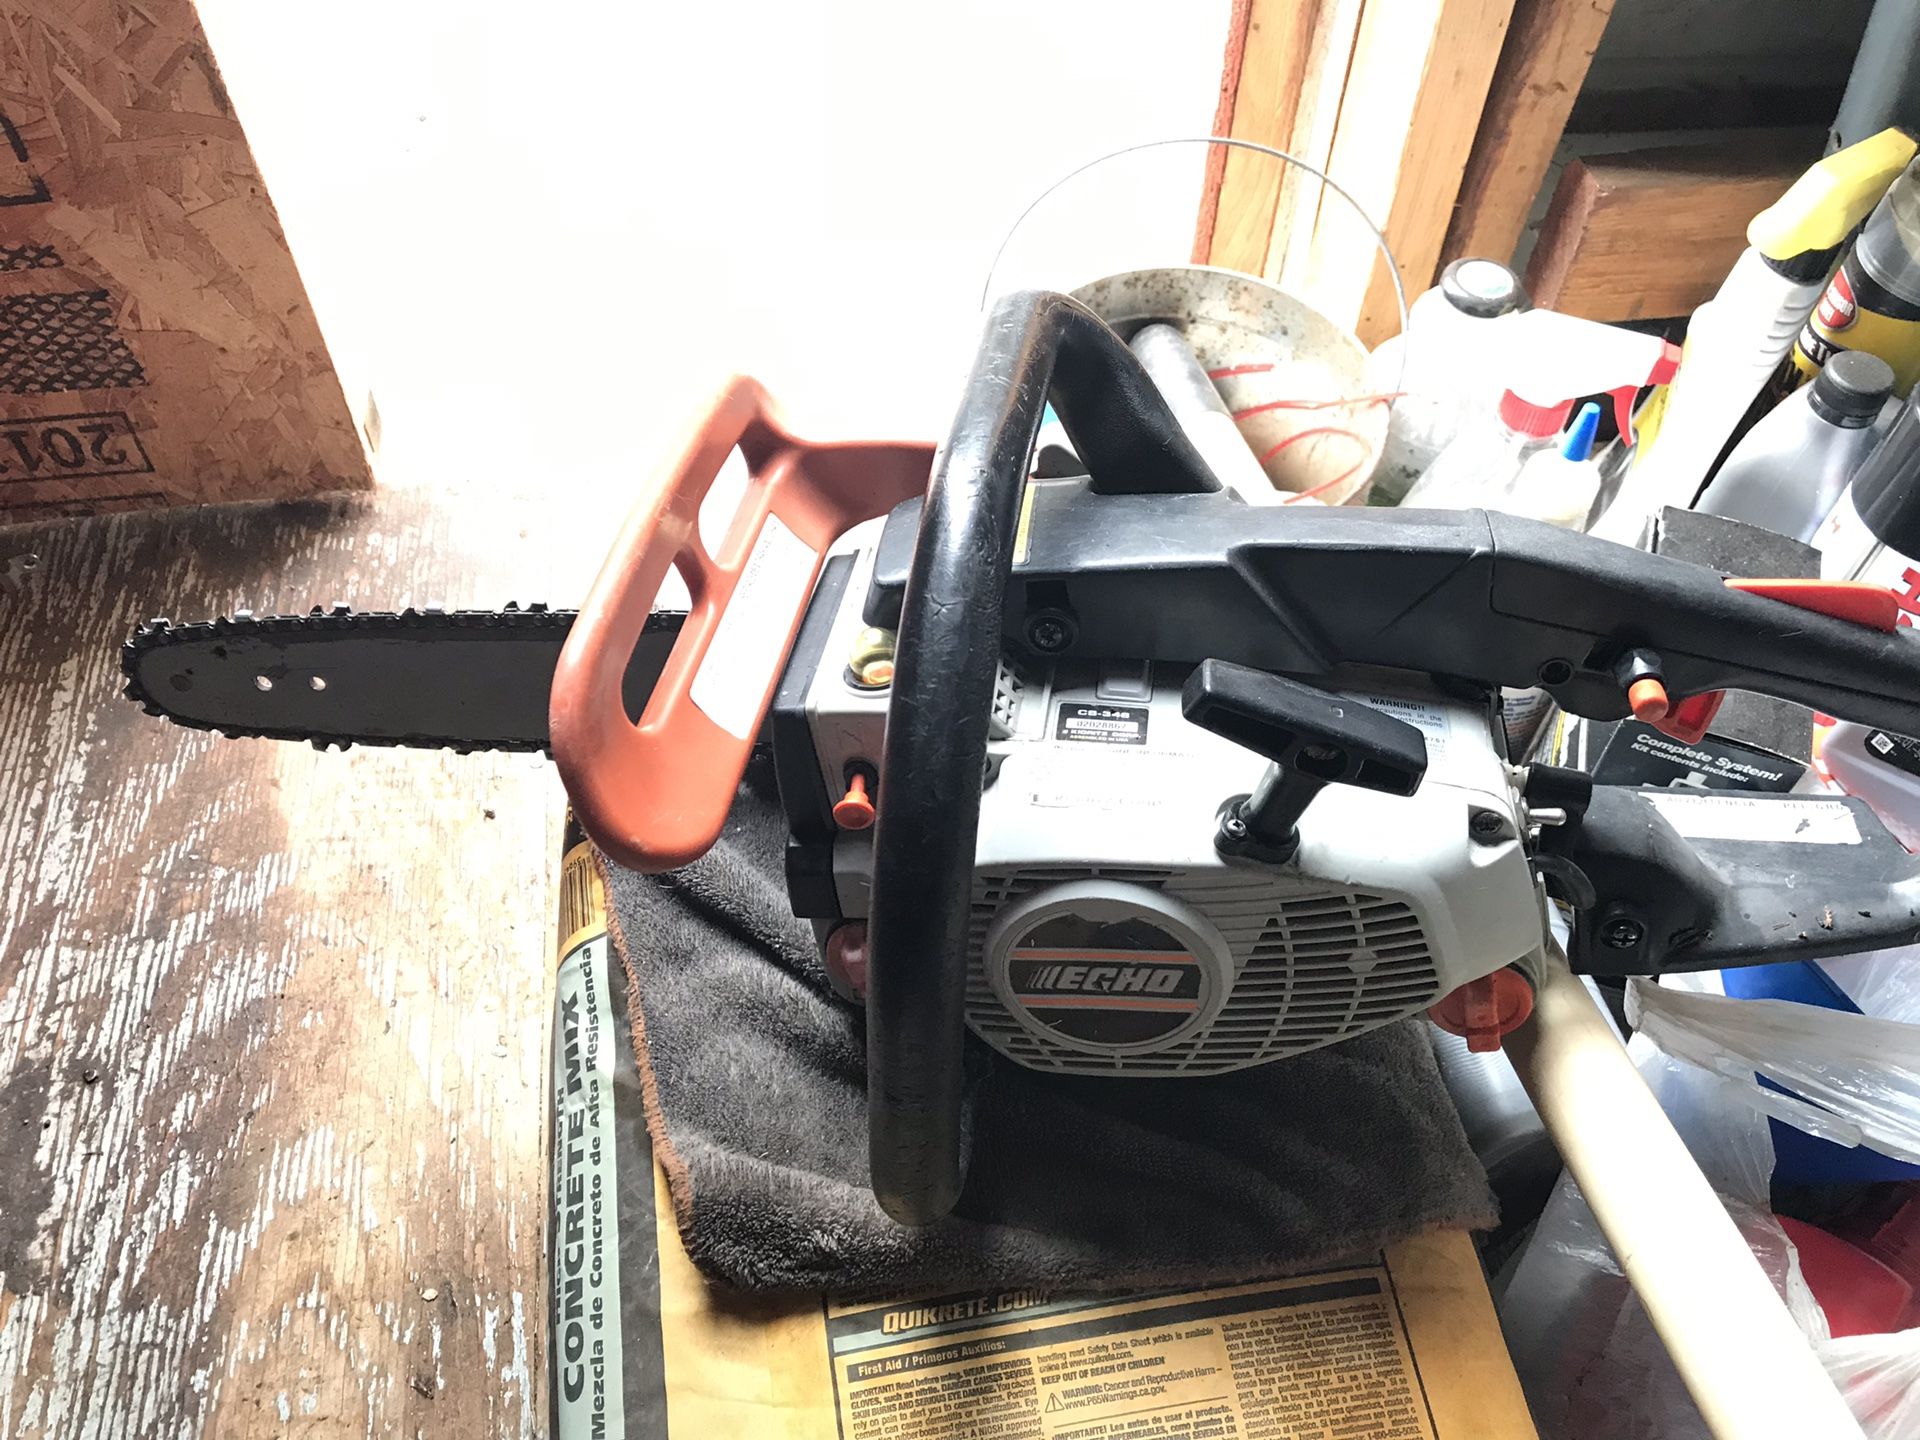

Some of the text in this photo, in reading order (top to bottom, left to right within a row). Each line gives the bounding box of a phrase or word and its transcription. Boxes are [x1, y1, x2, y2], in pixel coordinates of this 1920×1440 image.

[0, 423, 127, 473] 201
[1369, 697, 1425, 711] WARNING!!
[1630, 742, 1750, 783] Kit contents include:
[1635, 733, 1784, 782] Complete System!
[1056, 966, 1185, 993] ECHO
[561, 991, 585, 1403] CONCRETE MIX
[579, 946, 606, 1440] Mezcla de Concreto de Alta Resistencia
[858, 1363, 882, 1377] First
[885, 1359, 902, 1372] Aid
[912, 1350, 958, 1366] Primeros
[961, 1340, 1006, 1357] Auxilios:
[1041, 1356, 1166, 1386] KEEP OUT OF REACH OF CHILDREN
[896, 1379, 914, 1391] Read
[1062, 1384, 1103, 1400] WARNING:
[1104, 1379, 1130, 1392] Cancer
[1130, 1376, 1146, 1387] and
[1146, 1369, 1194, 1385] Reproductive
[851, 1396, 882, 1410] GLOVES,
[884, 1393, 902, 1404] such
[904, 1391, 914, 1399] as
[898, 1400, 914, 1411] AND
[1064, 1385, 1167, 1410] www.P65Warnings.ca.gov.
[854, 1427, 882, 1440] cement
[884, 1424, 898, 1434] can
[900, 1420, 922, 1430] cause
[964, 1410, 973, 1418] or
[870, 1418, 880, 1426] on
[881, 1414, 898, 1426] pain
[900, 1412, 907, 1420] to
[910, 1408, 926, 1418] alert
[927, 1406, 942, 1416] you
[944, 1404, 952, 1412] to
[970, 1428, 978, 1438] A
[978, 1424, 1004, 1436] NIOSH
[1006, 1416, 1042, 1432] approved
[1110, 1424, 1124, 1432] Lea
[1152, 1416, 1162, 1424] de
[1164, 1413, 1182, 1422] usar
[1170, 1423, 1190, 1432] como
[1224, 1414, 1234, 1423] de
[919, 1426, 940, 1437] boots
[940, 1422, 954, 1434] and
[1226, 1424, 1237, 1434] EN
